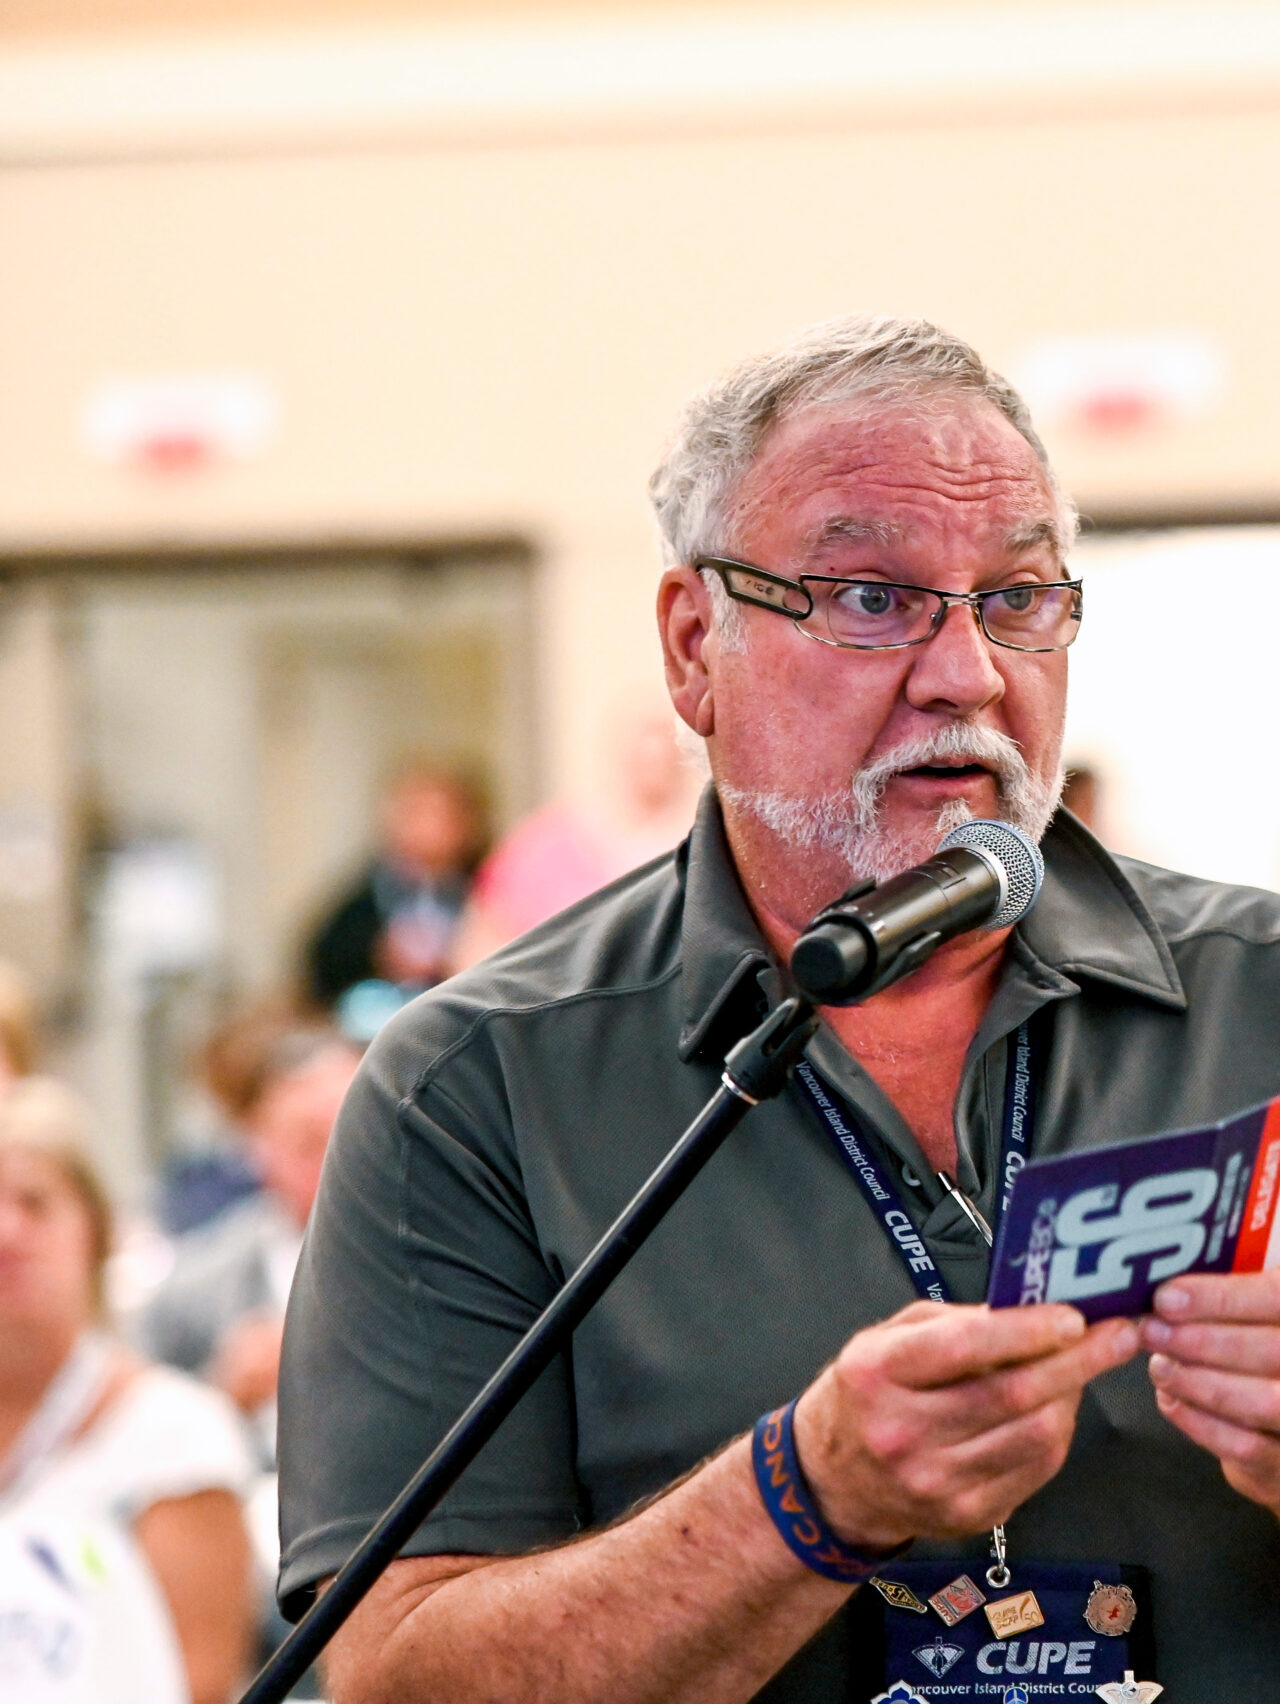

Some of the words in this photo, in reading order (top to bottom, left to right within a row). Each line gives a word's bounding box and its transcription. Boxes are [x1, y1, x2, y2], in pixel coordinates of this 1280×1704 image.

[1016, 1046, 1030, 1075] Island
[1013, 1069, 1030, 1104] District
[795, 1060, 832, 1109] Vancouver
[823, 1103, 847, 1136] Island
[839, 1130, 869, 1168] District
[860, 1164, 891, 1202] Council
[1010, 1103, 1028, 1144] Council
[884, 1209, 935, 1273] CUPE
[1045, 1169, 1219, 1302] 56
[931, 1599, 954, 1624] CUPE
[975, 1640, 1097, 1676] CUPE
